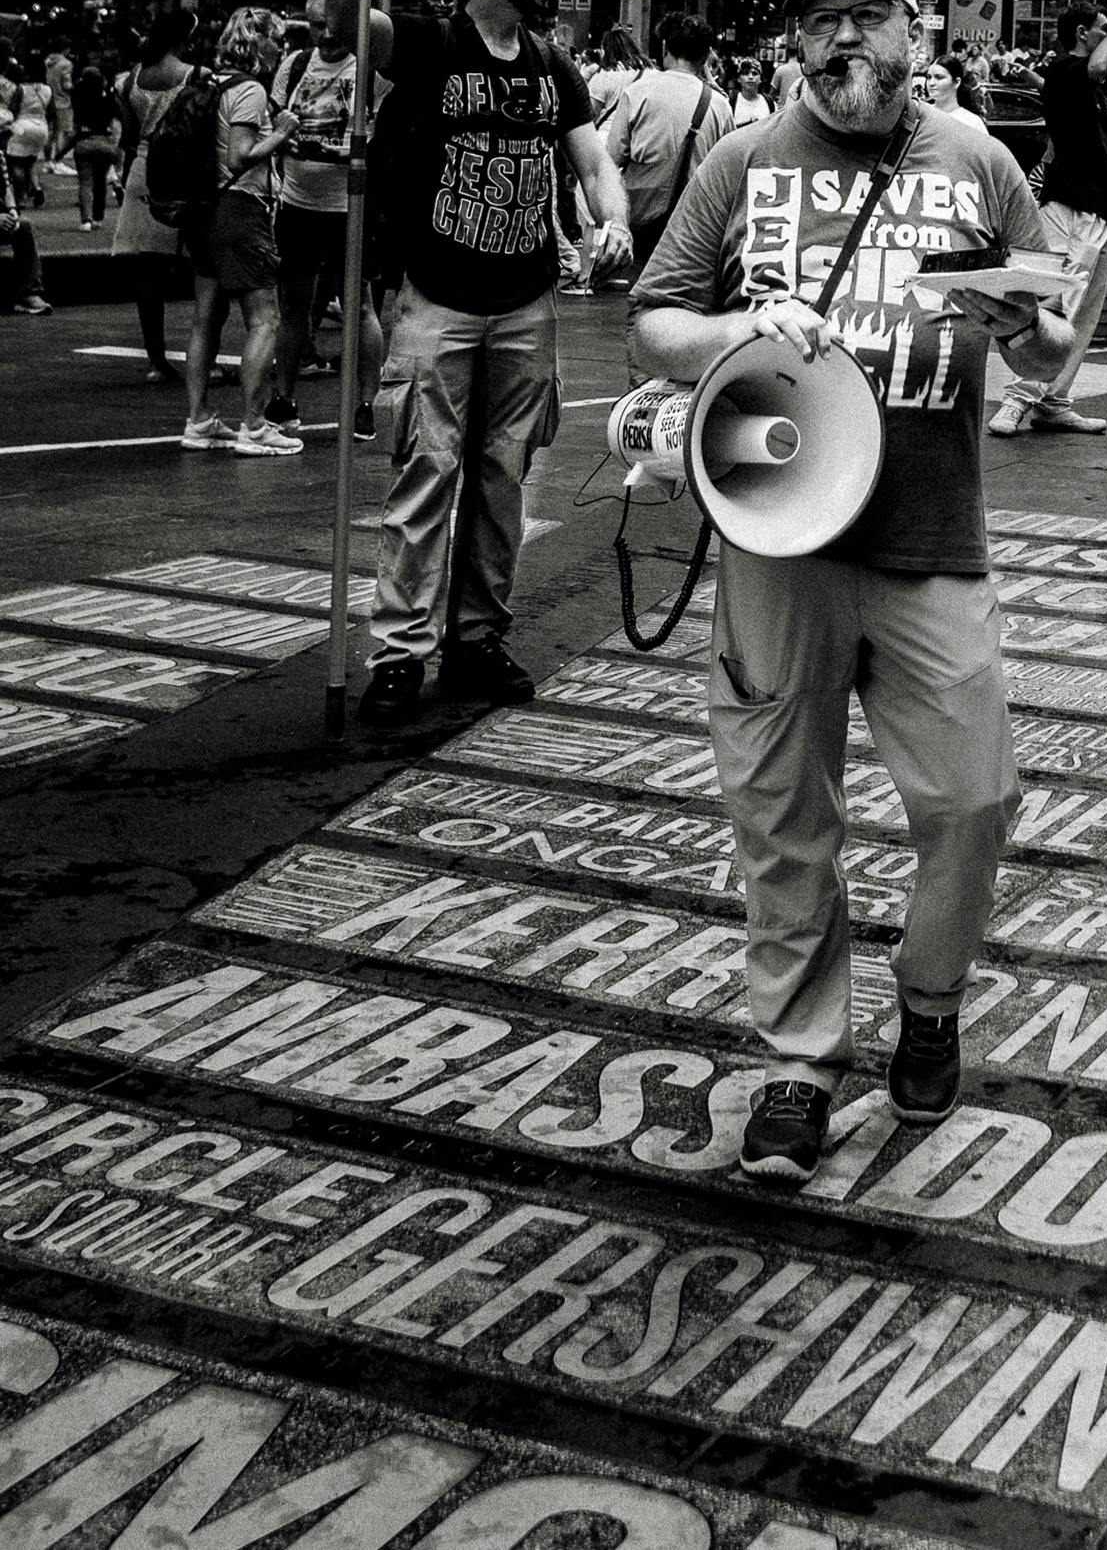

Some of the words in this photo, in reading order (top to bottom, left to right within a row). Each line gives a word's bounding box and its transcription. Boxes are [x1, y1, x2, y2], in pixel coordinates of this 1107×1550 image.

[953, 27, 996, 43] BLIND
[440, 143, 550, 207] JESUS
[810, 168, 981, 226] SAVES
[858, 215, 953, 251] from
[392, 777, 555, 817] ETHEL
[2, 1189, 295, 1290] SQUARE
